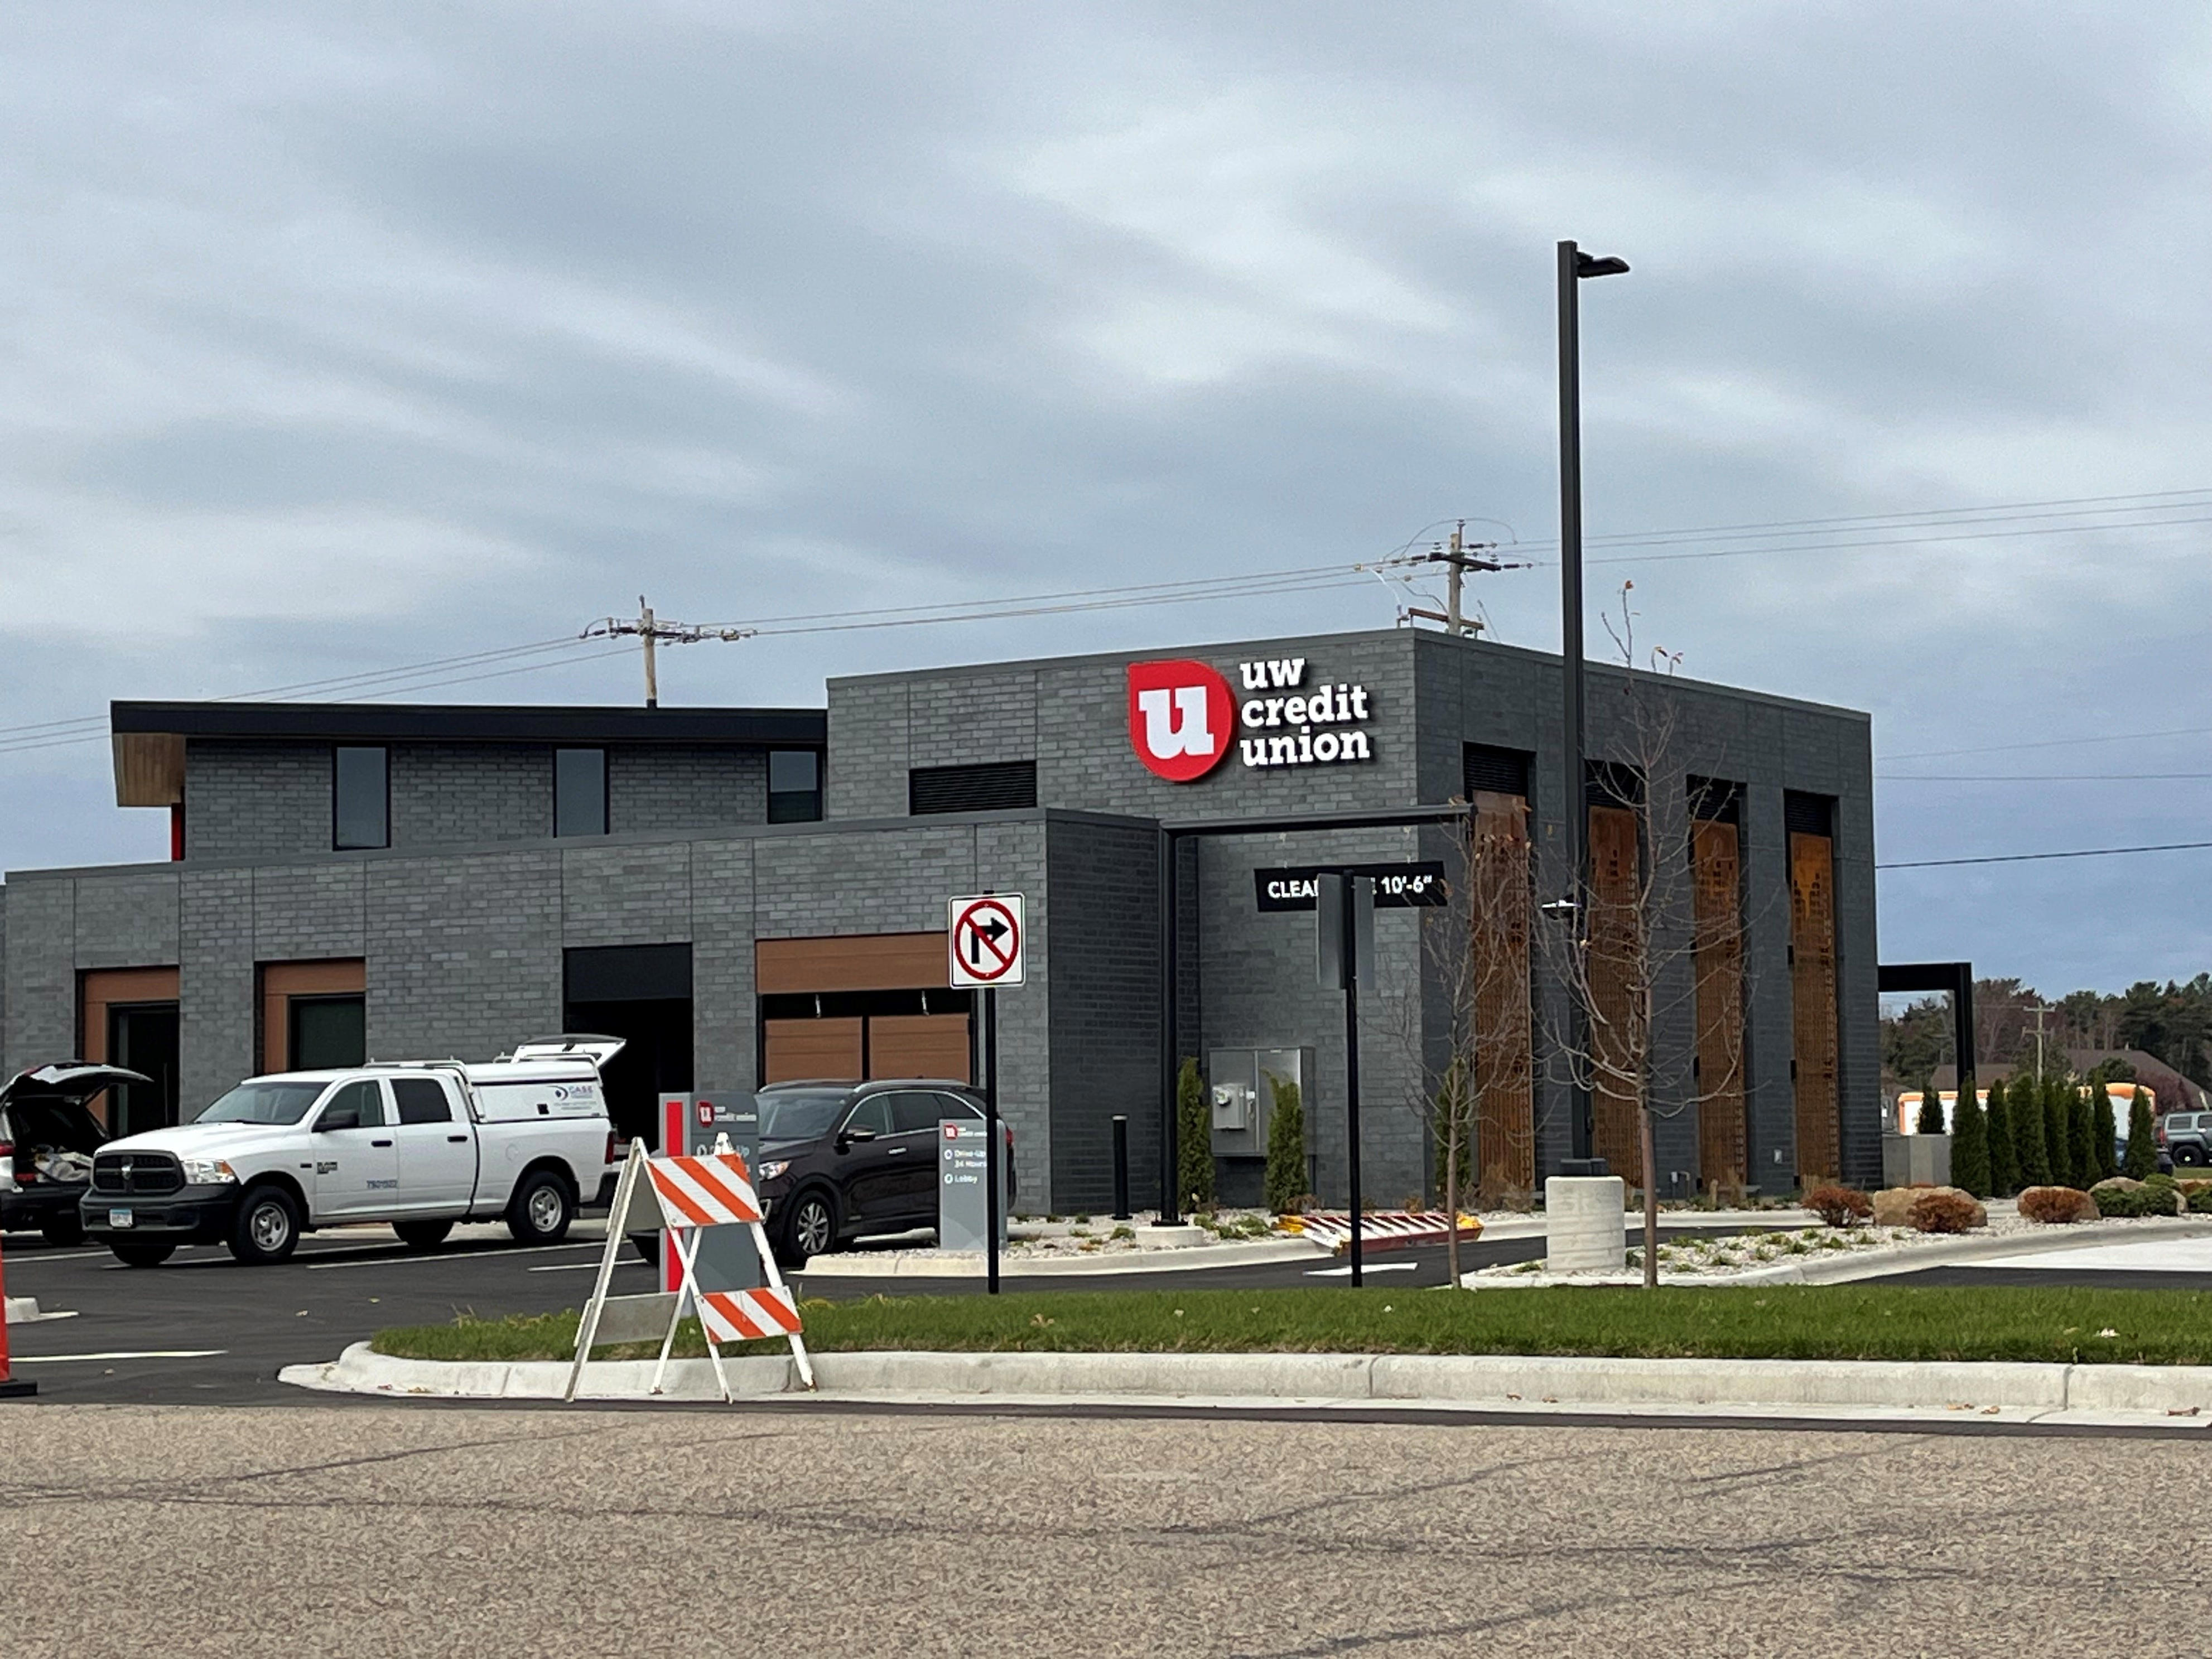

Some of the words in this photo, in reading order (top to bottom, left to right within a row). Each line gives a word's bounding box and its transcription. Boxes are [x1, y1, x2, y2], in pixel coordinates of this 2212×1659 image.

[1240, 658, 1305, 689] uw
[1139, 686, 1214, 759] u
[1241, 683, 1369, 727] credit
[1240, 726, 1370, 766] union
